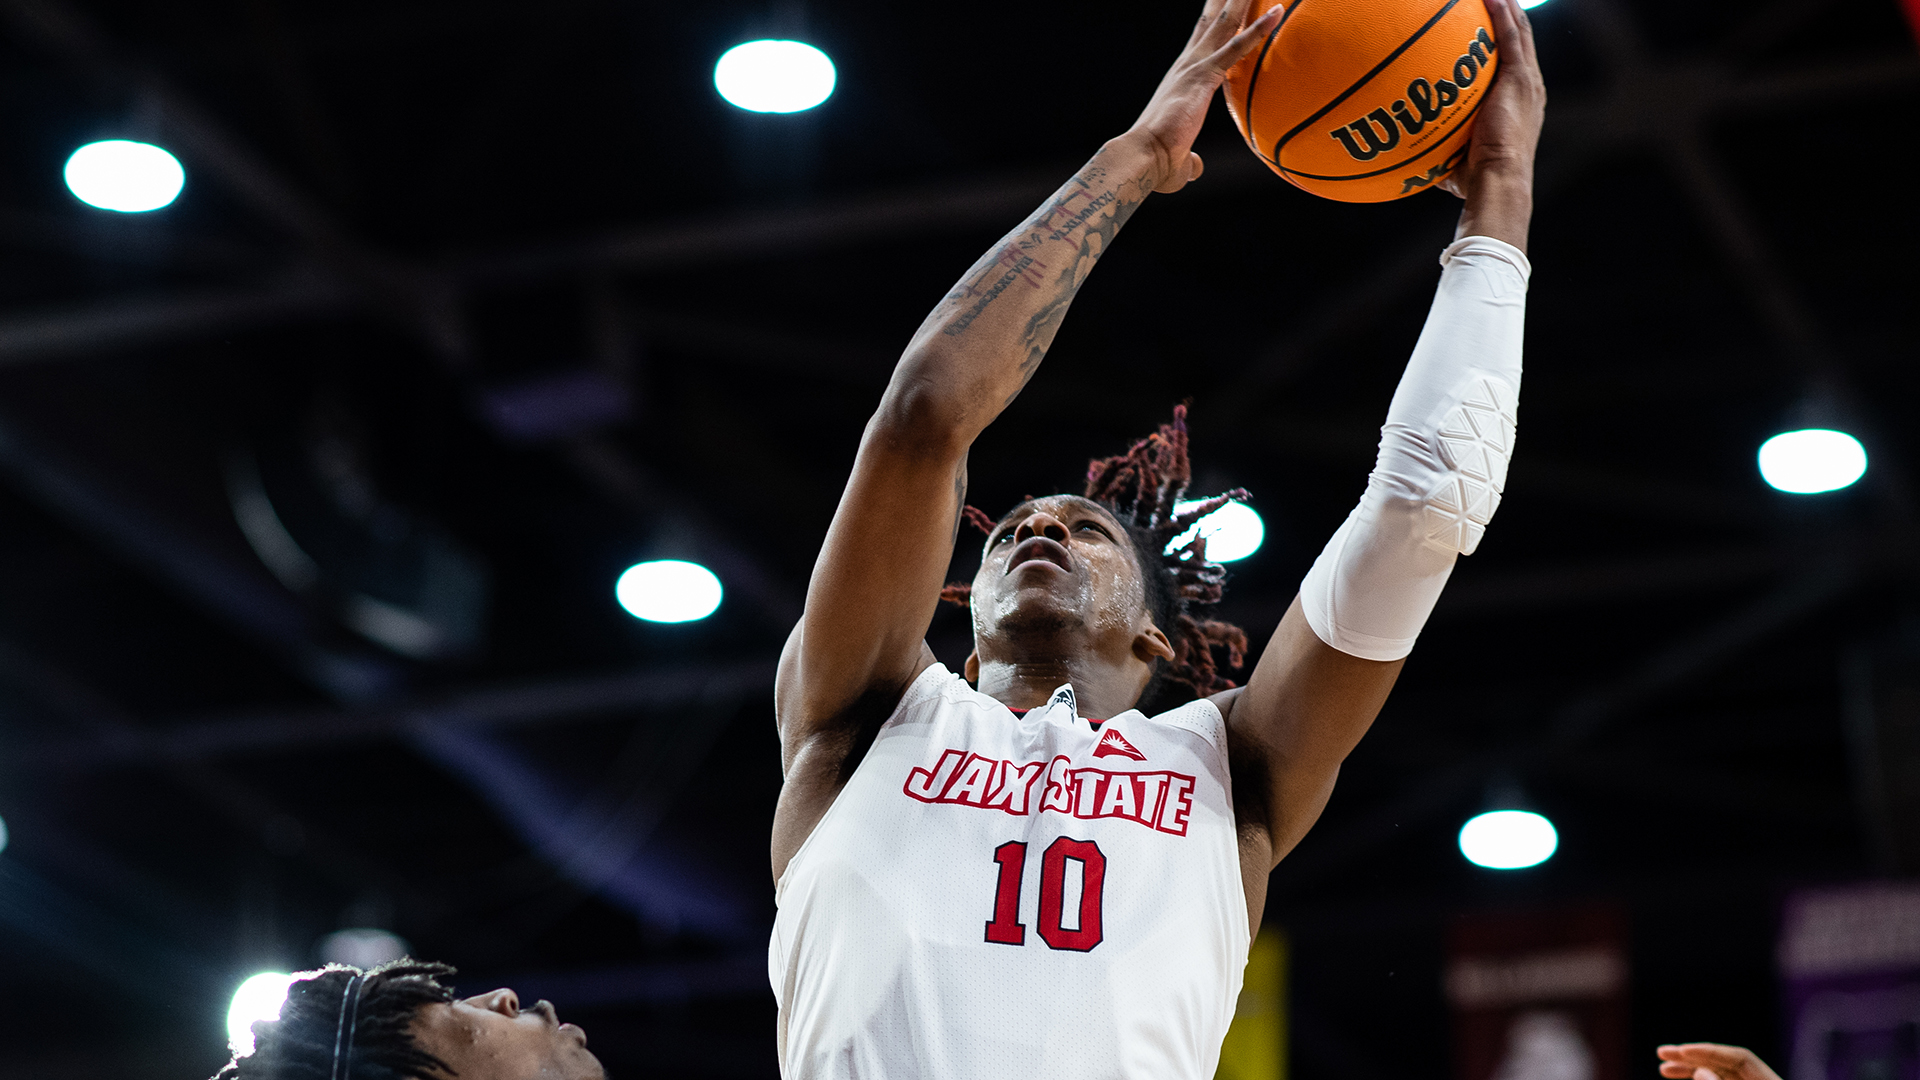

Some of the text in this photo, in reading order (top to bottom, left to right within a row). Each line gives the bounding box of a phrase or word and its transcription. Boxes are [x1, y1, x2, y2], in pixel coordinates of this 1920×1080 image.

[1329, 26, 1497, 162] Wilson
[903, 748, 1197, 838] JAX STATE
[984, 835, 1108, 954] 10
